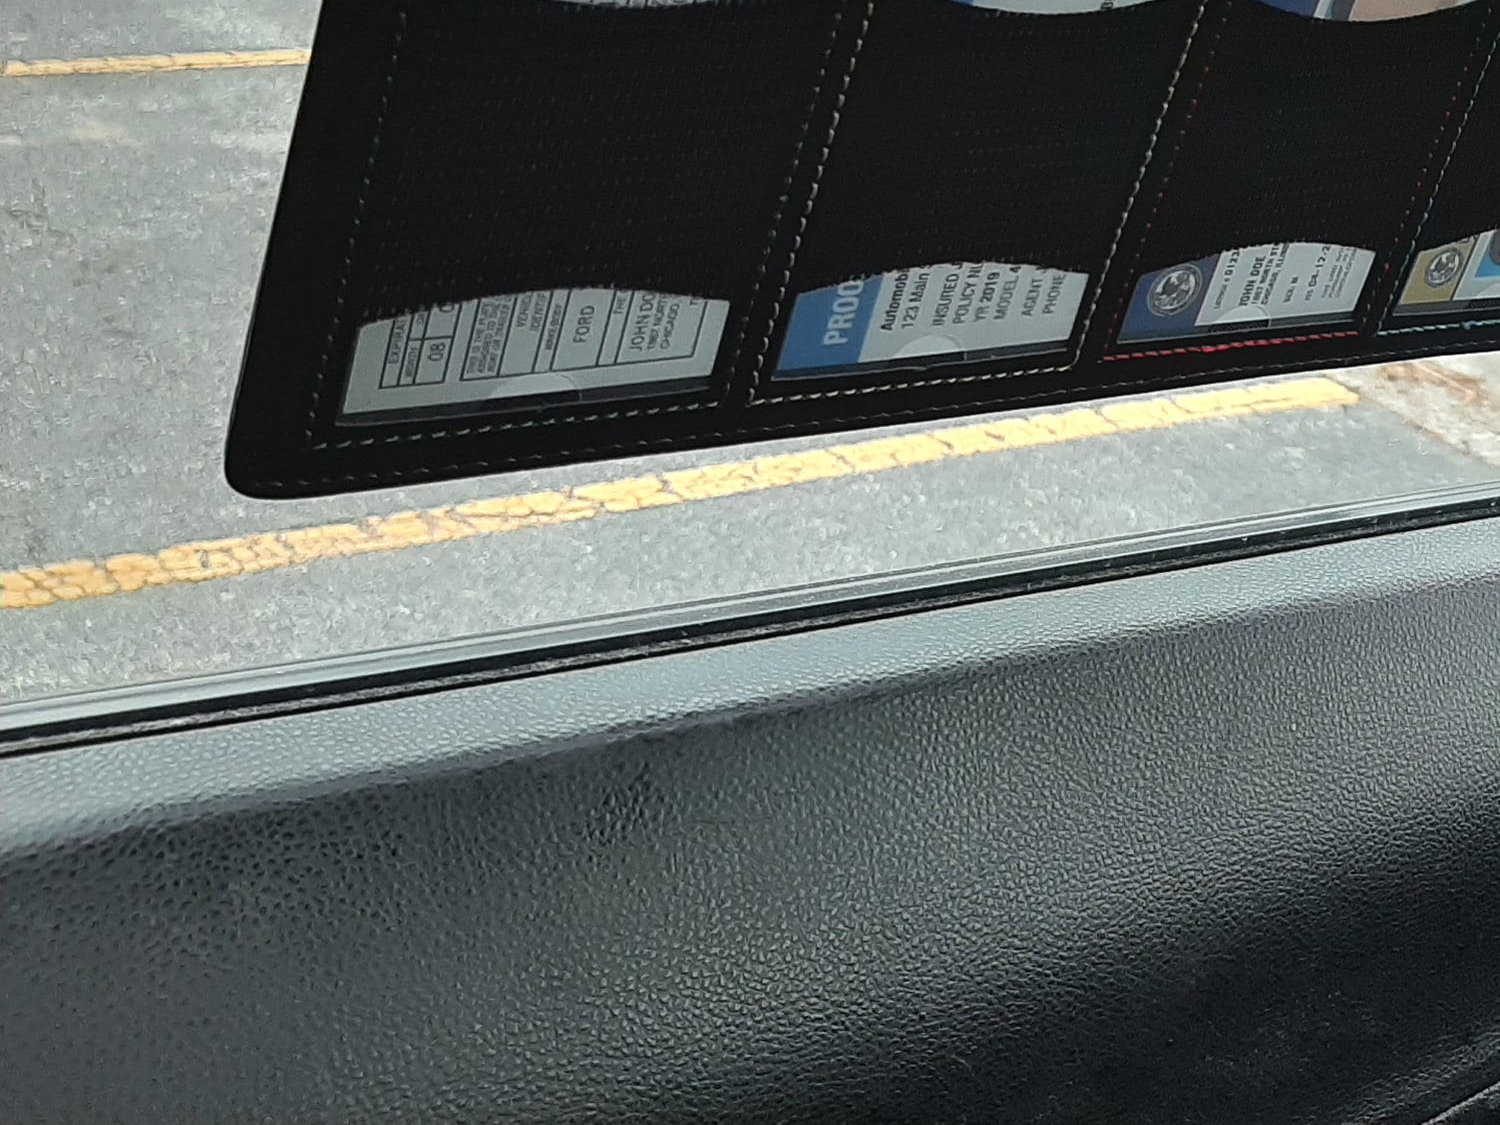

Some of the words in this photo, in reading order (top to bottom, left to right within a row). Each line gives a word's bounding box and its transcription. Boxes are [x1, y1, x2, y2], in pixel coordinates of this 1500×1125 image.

[901, 306, 916, 330] 123
[909, 271, 931, 307] Main
[931, 271, 959, 327] INSURED
[953, 279, 977, 325] POLICY
[979, 271, 1000, 307] 2019
[994, 273, 1021, 320] MODEL
[1021, 277, 1044, 317] AGENT
[1043, 274, 1067, 315] PHONE
[573, 304, 596, 344] FORD
[629, 311, 651, 352] JOHN
